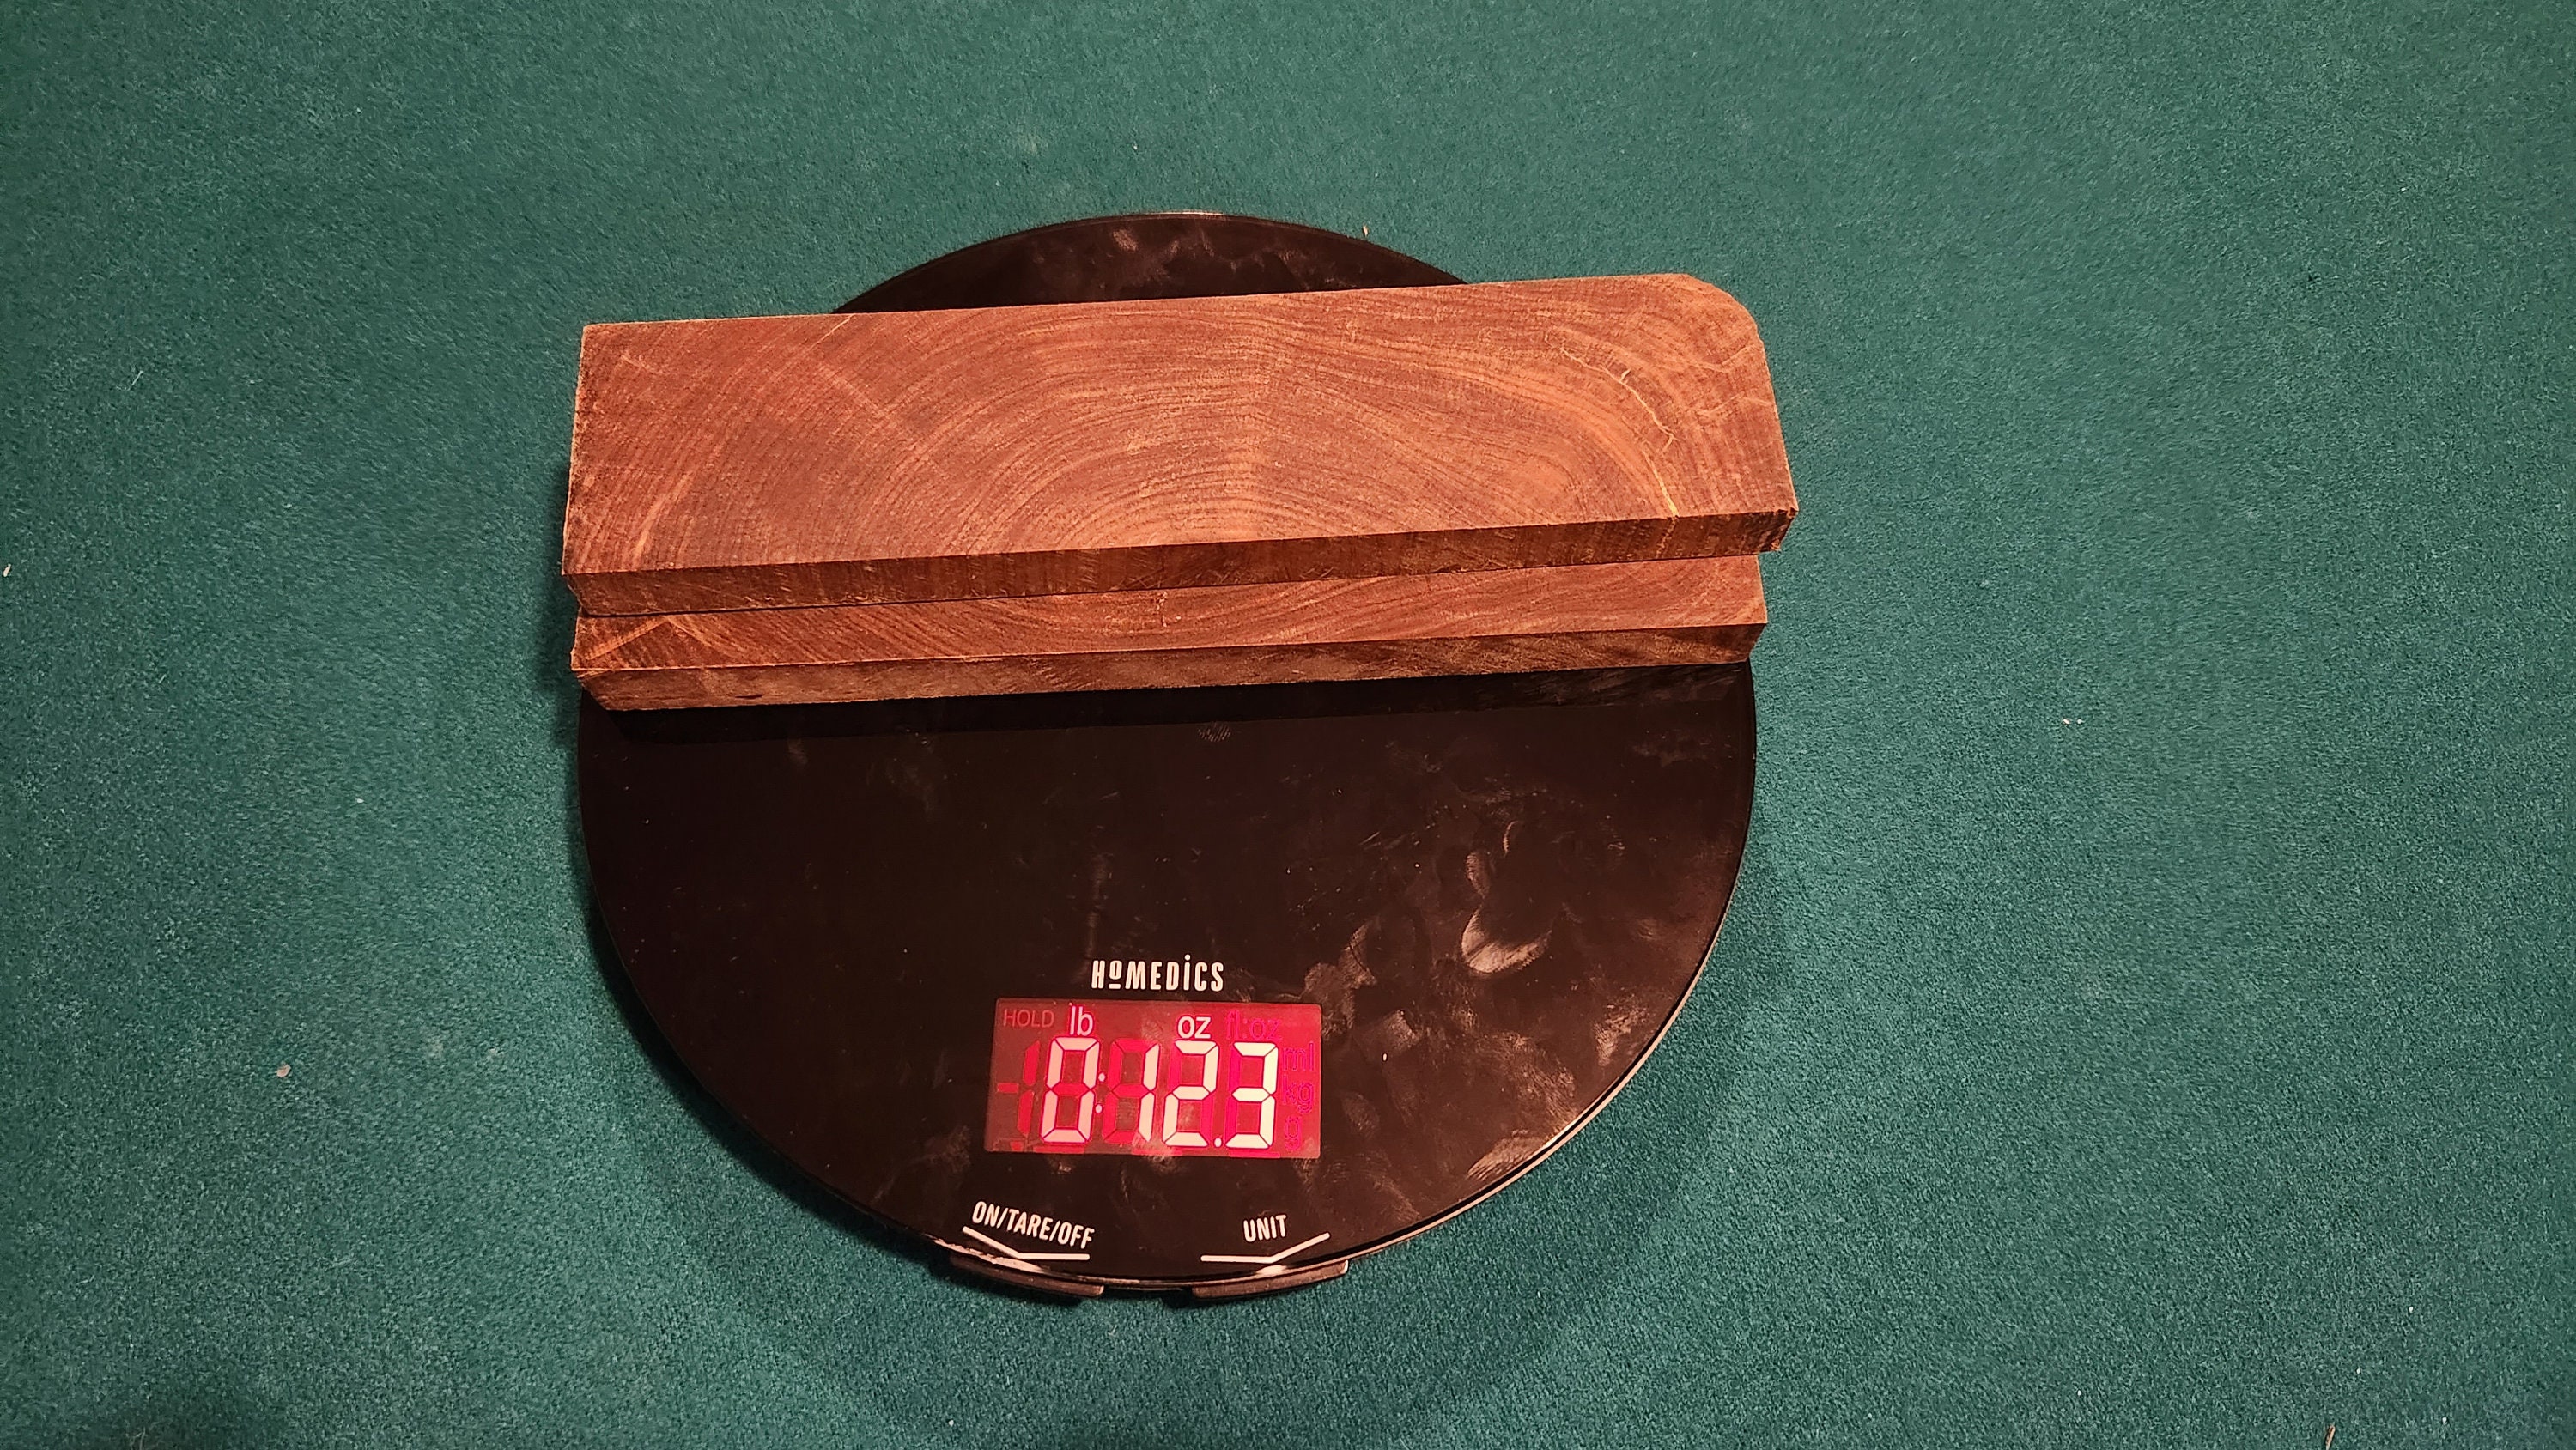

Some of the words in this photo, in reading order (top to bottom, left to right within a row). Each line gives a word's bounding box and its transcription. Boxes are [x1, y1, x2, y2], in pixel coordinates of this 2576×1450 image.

[1002, 1008, 1055, 1028] HOLD
[1069, 1005, 1094, 1037] lb
[1177, 1015, 1212, 1040] oz
[971, 1200, 1096, 1250] ON/TARE/OFF
[1242, 1214, 1287, 1243] UNIT
